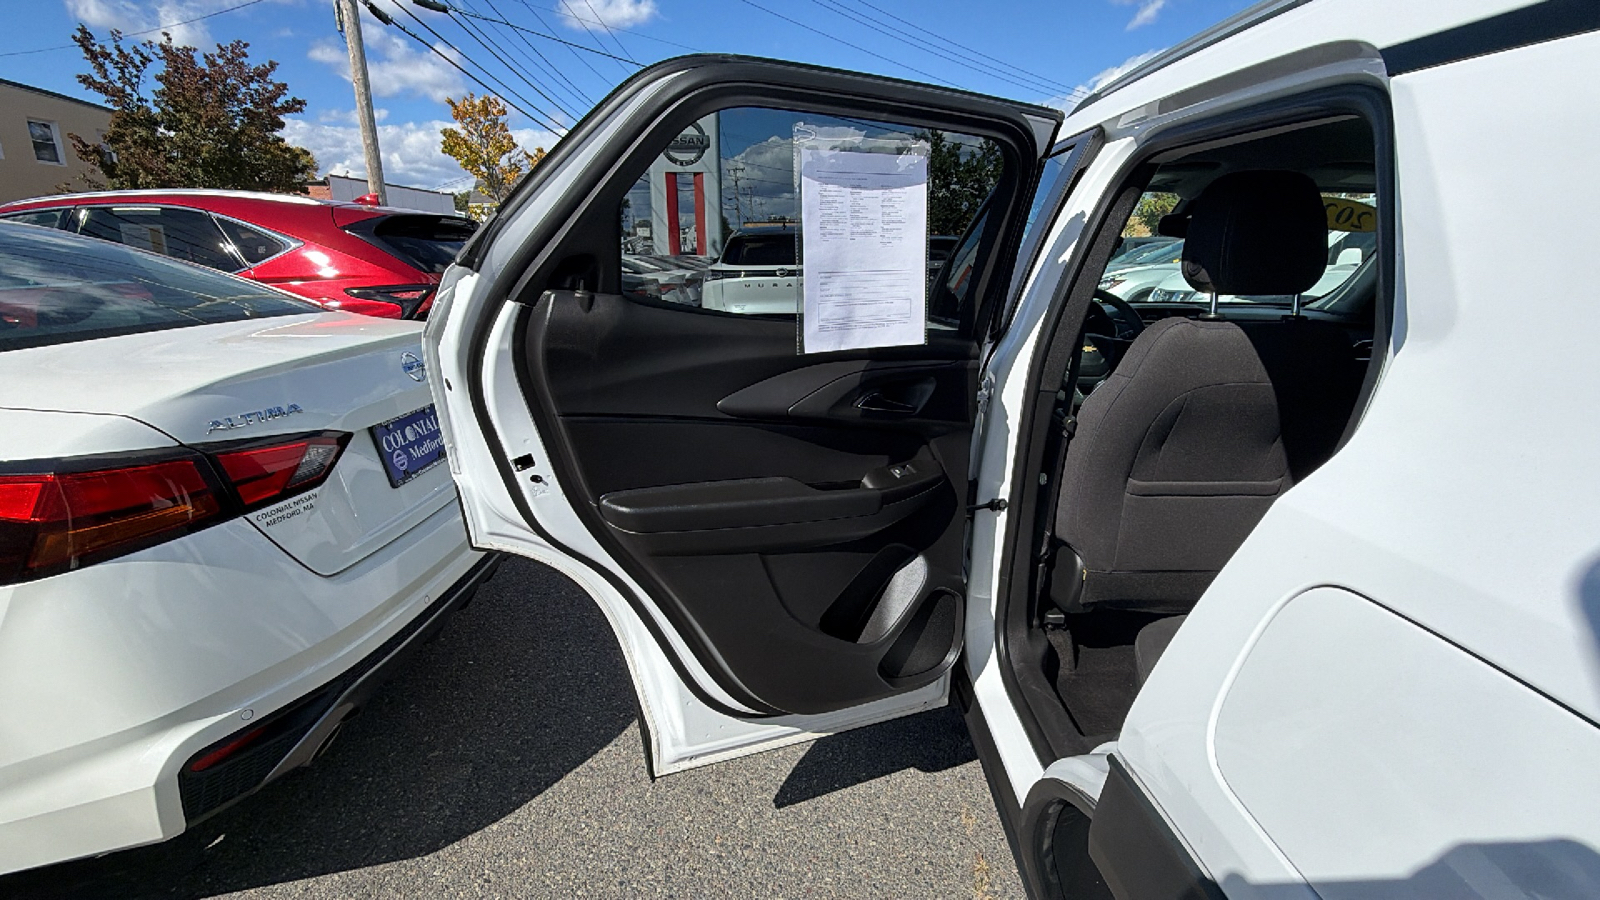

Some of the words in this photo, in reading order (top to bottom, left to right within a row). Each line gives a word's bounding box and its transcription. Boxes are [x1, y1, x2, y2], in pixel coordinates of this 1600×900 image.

[670, 136, 704, 146] SSAN
[206, 403, 303, 435] ALTIMA
[382, 414, 440, 453] COLONIAL
[409, 433, 444, 461] Medford
[256, 502, 293, 522] COLONIAL
[293, 492, 318, 507] NISSAN
[303, 502, 314, 512] MA
